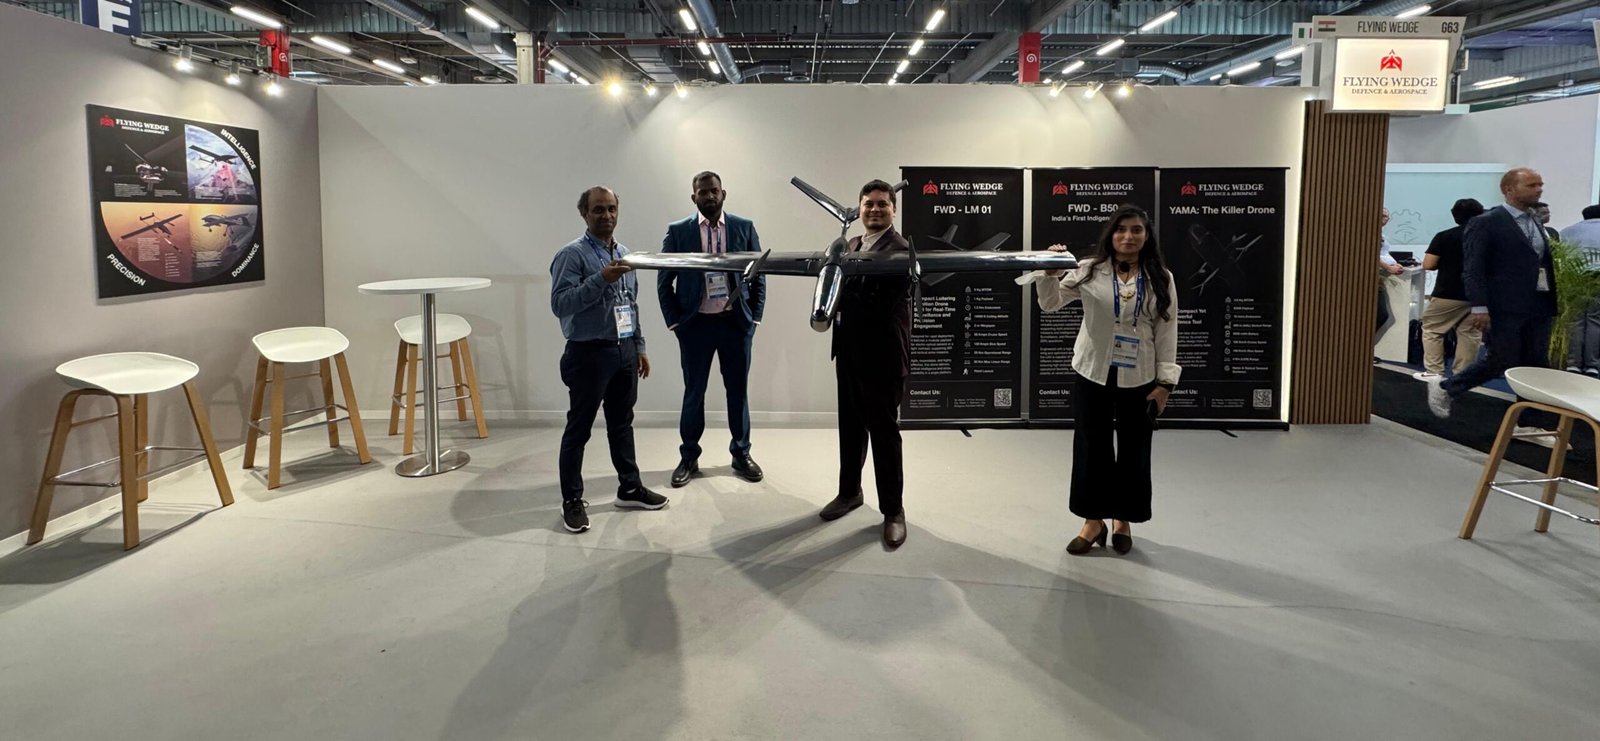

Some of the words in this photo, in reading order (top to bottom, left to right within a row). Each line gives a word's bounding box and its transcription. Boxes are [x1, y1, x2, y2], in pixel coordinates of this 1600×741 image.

[1357, 20, 1387, 33] FLYING
[1389, 21, 1419, 34] WEDGE
[1441, 22, 1459, 34] G63
[1343, 76, 1388, 87] FLYING
[1392, 77, 1438, 87] WEDGE
[116, 118, 143, 128] FLYING
[144, 122, 170, 132] WEDGE
[220, 128, 256, 170] INTELLIGENCE
[934, 205, 956, 214] FWD
[965, 205, 979, 214] LM
[981, 205, 991, 214] 01
[1068, 204, 1090, 212] FWD
[1100, 204, 1118, 212] B50
[1202, 206, 1219, 214] The
[232, 243, 260, 277] DOMINANCE
[106, 254, 146, 286] PRECISION
